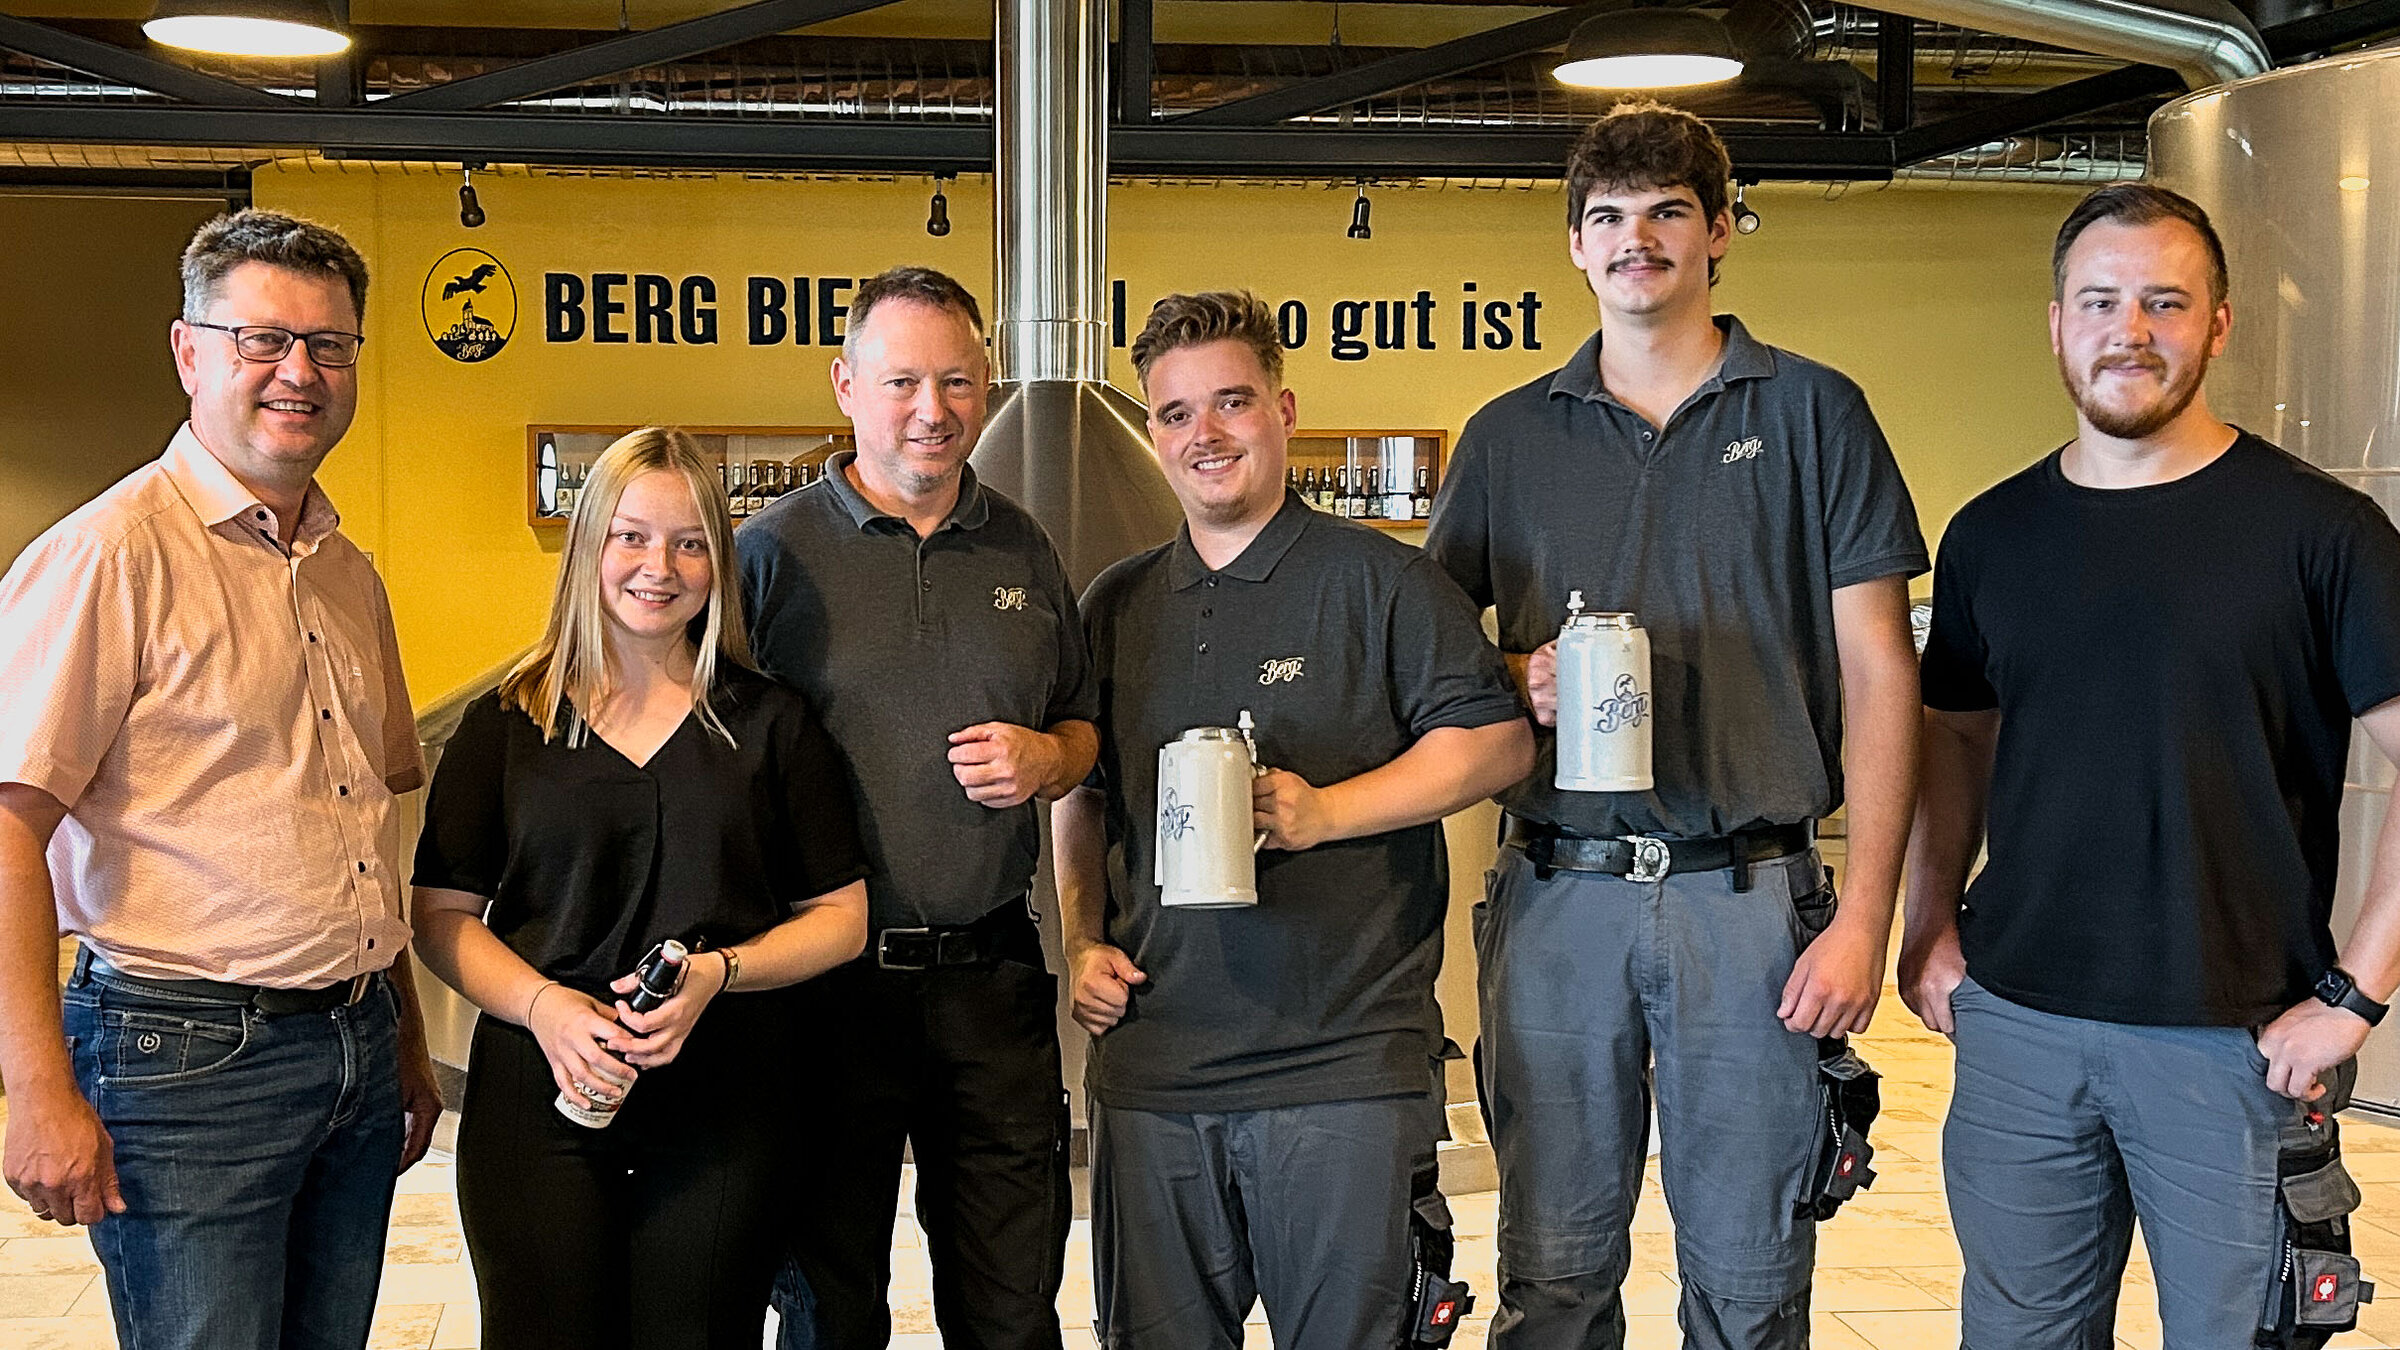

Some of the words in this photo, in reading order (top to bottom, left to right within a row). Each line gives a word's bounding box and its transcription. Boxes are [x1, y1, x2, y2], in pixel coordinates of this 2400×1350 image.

[545, 273, 717, 345] BERG
[747, 276, 874, 346] BIE
[1331, 290, 1437, 361] gut
[1462, 282, 1542, 350] ist
[1721, 436, 1764, 464] Berg
[993, 587, 1028, 611] Berg
[1259, 657, 1304, 685] Berg
[1594, 692, 1649, 733] Berg
